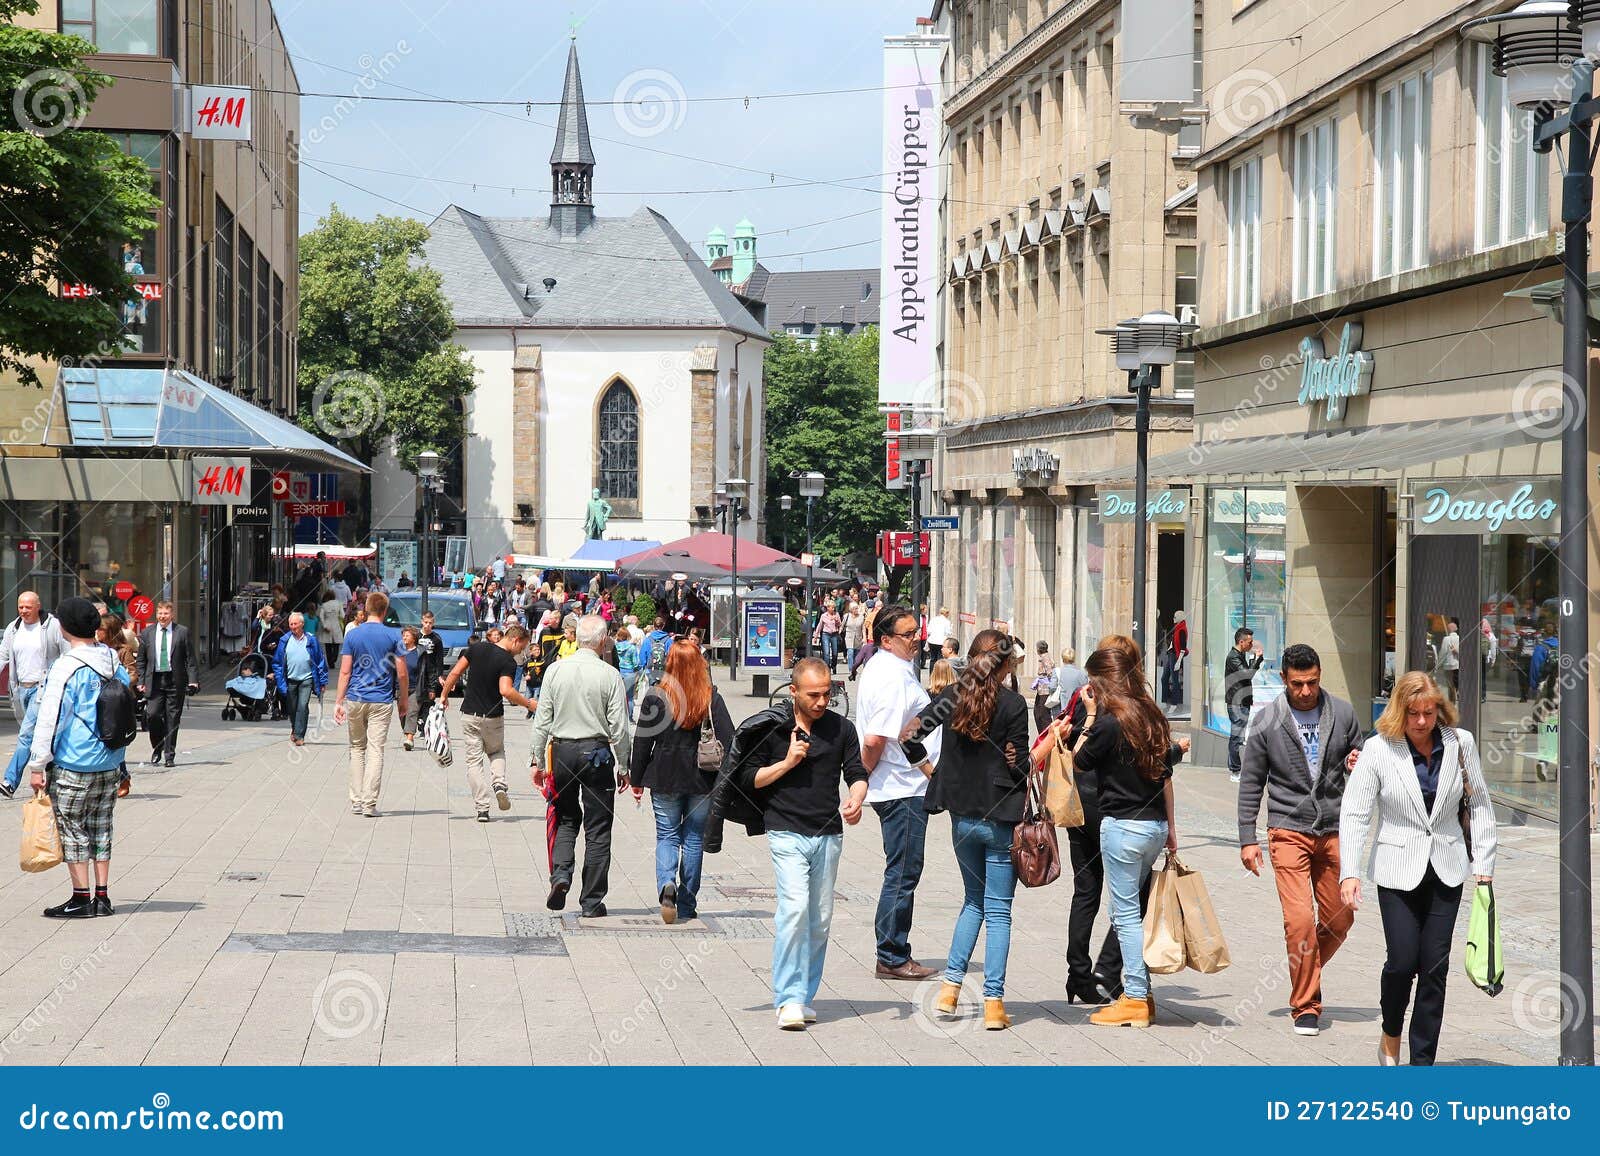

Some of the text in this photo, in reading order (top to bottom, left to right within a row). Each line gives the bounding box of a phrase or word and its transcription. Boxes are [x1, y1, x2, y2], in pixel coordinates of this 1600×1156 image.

[198, 96, 246, 129] H&M
[893, 105, 927, 344] AppelrathCüpper
[199, 466, 246, 497] H&M
[293, 504, 328, 515] ESPRIT
[1422, 484, 1557, 532] Douglas
